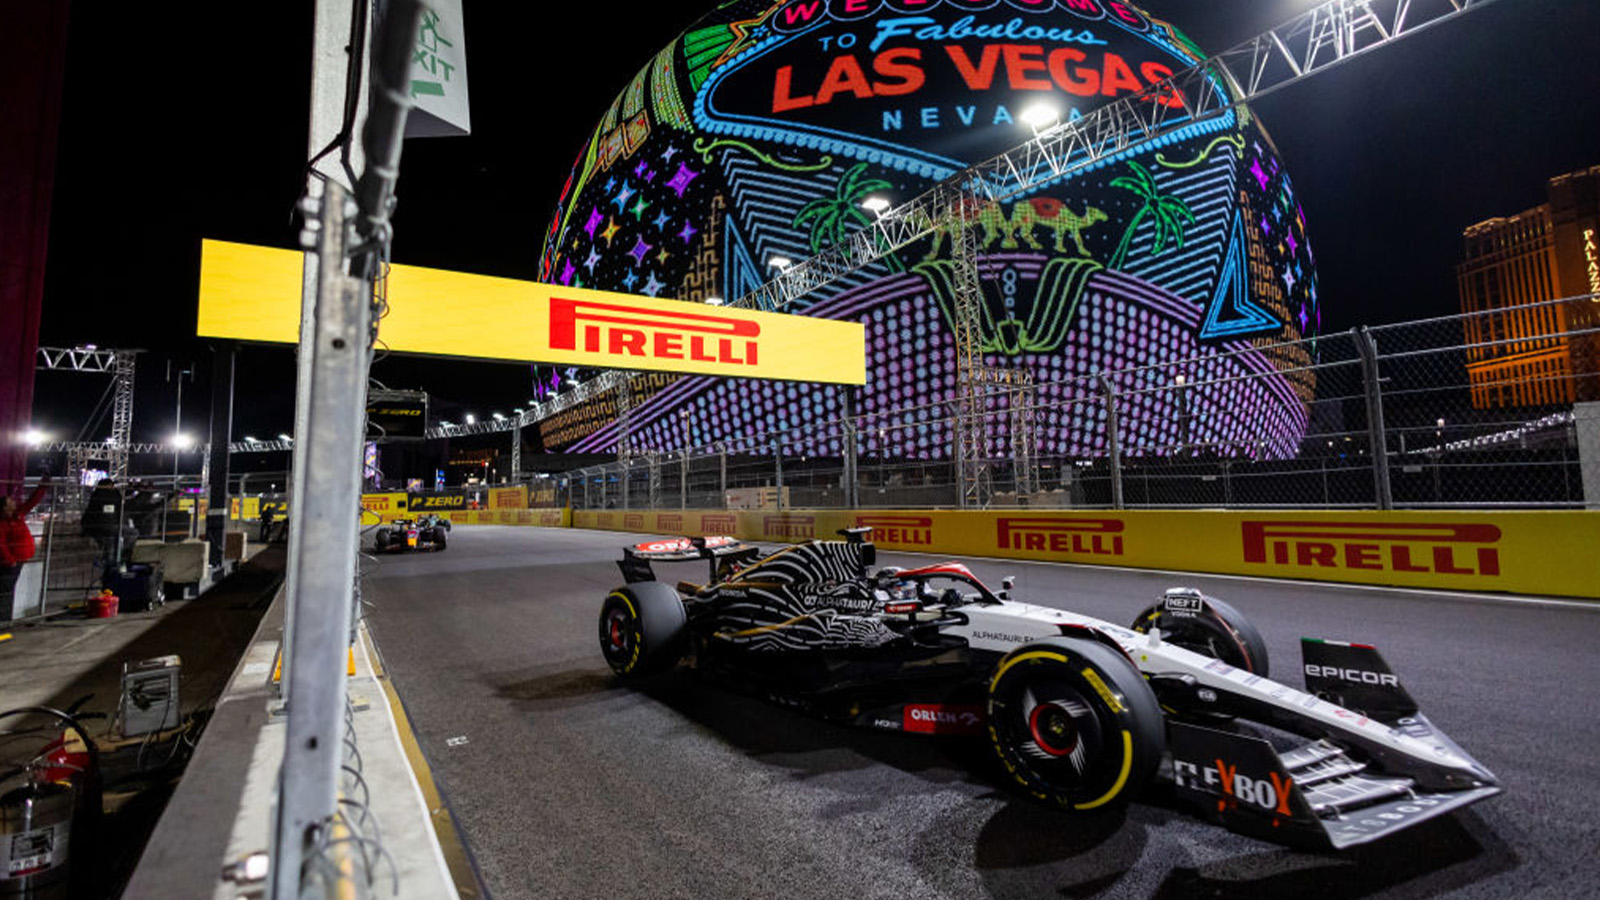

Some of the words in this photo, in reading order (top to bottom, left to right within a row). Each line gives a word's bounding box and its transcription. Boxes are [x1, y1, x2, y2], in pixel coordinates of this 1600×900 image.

[818, 33, 857, 51] TO
[869, 15, 1108, 52] Fabulous
[411, 47, 455, 82] XIT
[772, 46, 926, 113] LAS
[944, 44, 1186, 108] VEGAS
[882, 105, 1085, 131] NEVAA
[549, 297, 761, 366] PIRELLI
[424, 496, 464, 506] ZERO
[702, 515, 737, 534] PIRELLI
[763, 515, 815, 538] PIRELLI
[997, 518, 1124, 555] PIRELLI
[1241, 521, 1502, 576] PIRELLI
[1169, 599, 1198, 609] NEFT
[911, 708, 957, 723] ORLEN
